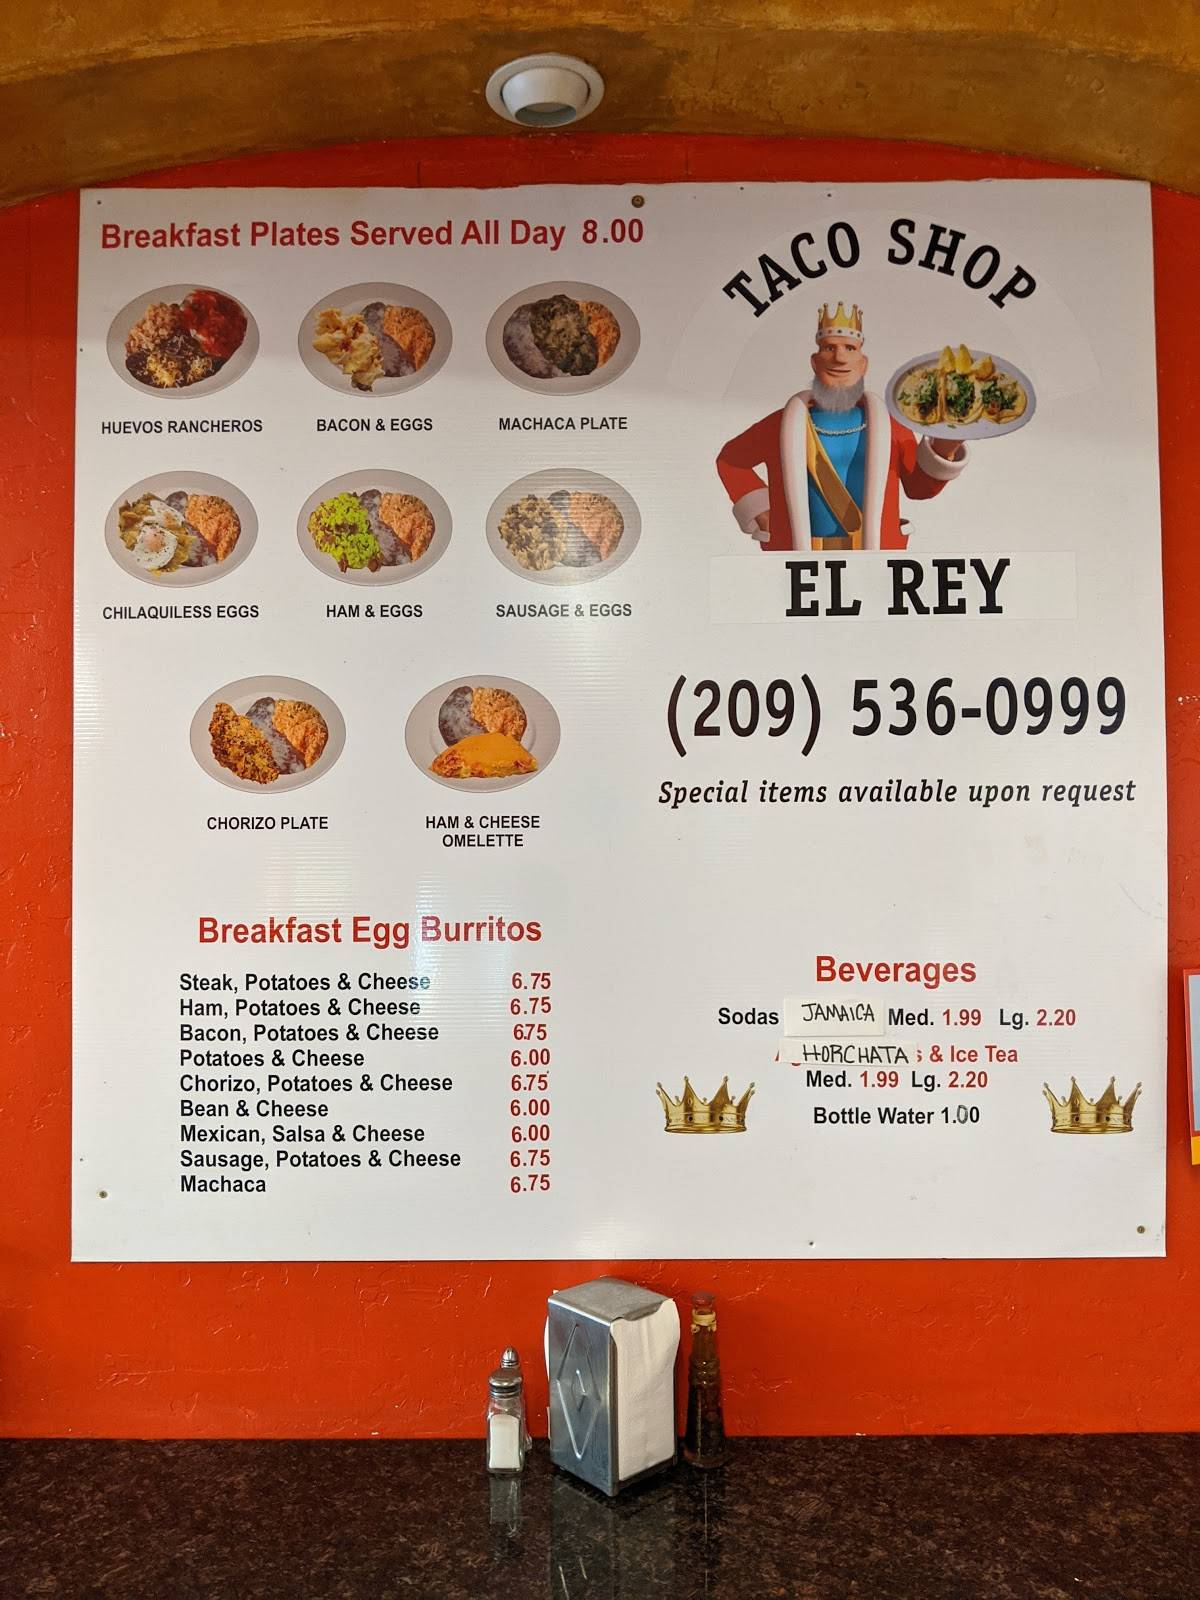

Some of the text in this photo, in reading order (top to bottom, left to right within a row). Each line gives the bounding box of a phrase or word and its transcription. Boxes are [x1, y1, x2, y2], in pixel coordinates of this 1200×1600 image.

[101, 218, 644, 252] Breakfast Plates Served All Day 8.00
[722, 217, 1037, 318] TACO SHOP
[101, 419, 263, 435] HUEVOS RANCHEROS
[316, 417, 433, 432] BACON & EGGS
[498, 416, 628, 431] MACHACA PLATE
[784, 557, 1011, 618] EL REY
[102, 604, 260, 620] CHILAQUILESS EGGS
[326, 604, 423, 618] HAM & EGGS
[495, 603, 632, 618] SAUSAGE & EGGS
[667, 673, 1126, 758] (209) 536-0999
[658, 778, 1137, 810] Special items available upon request
[206, 816, 329, 830] CHORIZO PLATE
[425, 815, 541, 829] HAM & CHEESE
[442, 833, 524, 848] OMELETTE
[199, 915, 542, 950] Breakfast Egg Burritos
[511, 972, 552, 990] 6.75
[816, 955, 977, 990] Beverages
[179, 972, 431, 995] Steak, Potatoes & Cheese
[180, 997, 421, 1020] Ham, Potatoes & Cheese
[510, 995, 552, 1016] 6.75
[800, 1002, 875, 1023] JAMAICA
[717, 1007, 780, 1026] Sodas
[888, 1008, 1076, 1031] Med. 1.99 Lg. 2.20
[180, 1022, 439, 1045] Bacon, Potatoes & Cheese
[180, 1048, 365, 1067] Potatoes & Cheese
[510, 1047, 551, 1068] 6.00
[802, 1043, 910, 1065] HORCHATA
[929, 1044, 944, 1063] &
[950, 1044, 979, 1063] Ice
[984, 1044, 1018, 1063] Tea
[179, 1073, 453, 1096] Chorizo, Potatoes & Cheese
[511, 1073, 549, 1092] 6.75
[806, 1069, 988, 1093] Med. 1.99 Lg. 2.20
[180, 1099, 329, 1118] Bean & Cheese
[510, 1098, 551, 1117] 6.00
[813, 1104, 980, 1125] Bottle Water 1.00
[180, 1124, 425, 1146] Mexican, Salsa & Cheese
[511, 1123, 551, 1143] 6.00
[180, 1149, 461, 1172] Sausage, Potatoes & Cheese
[510, 1148, 551, 1168] 6.75
[180, 1174, 266, 1193] Machaca
[510, 1173, 551, 1194] 6.75
